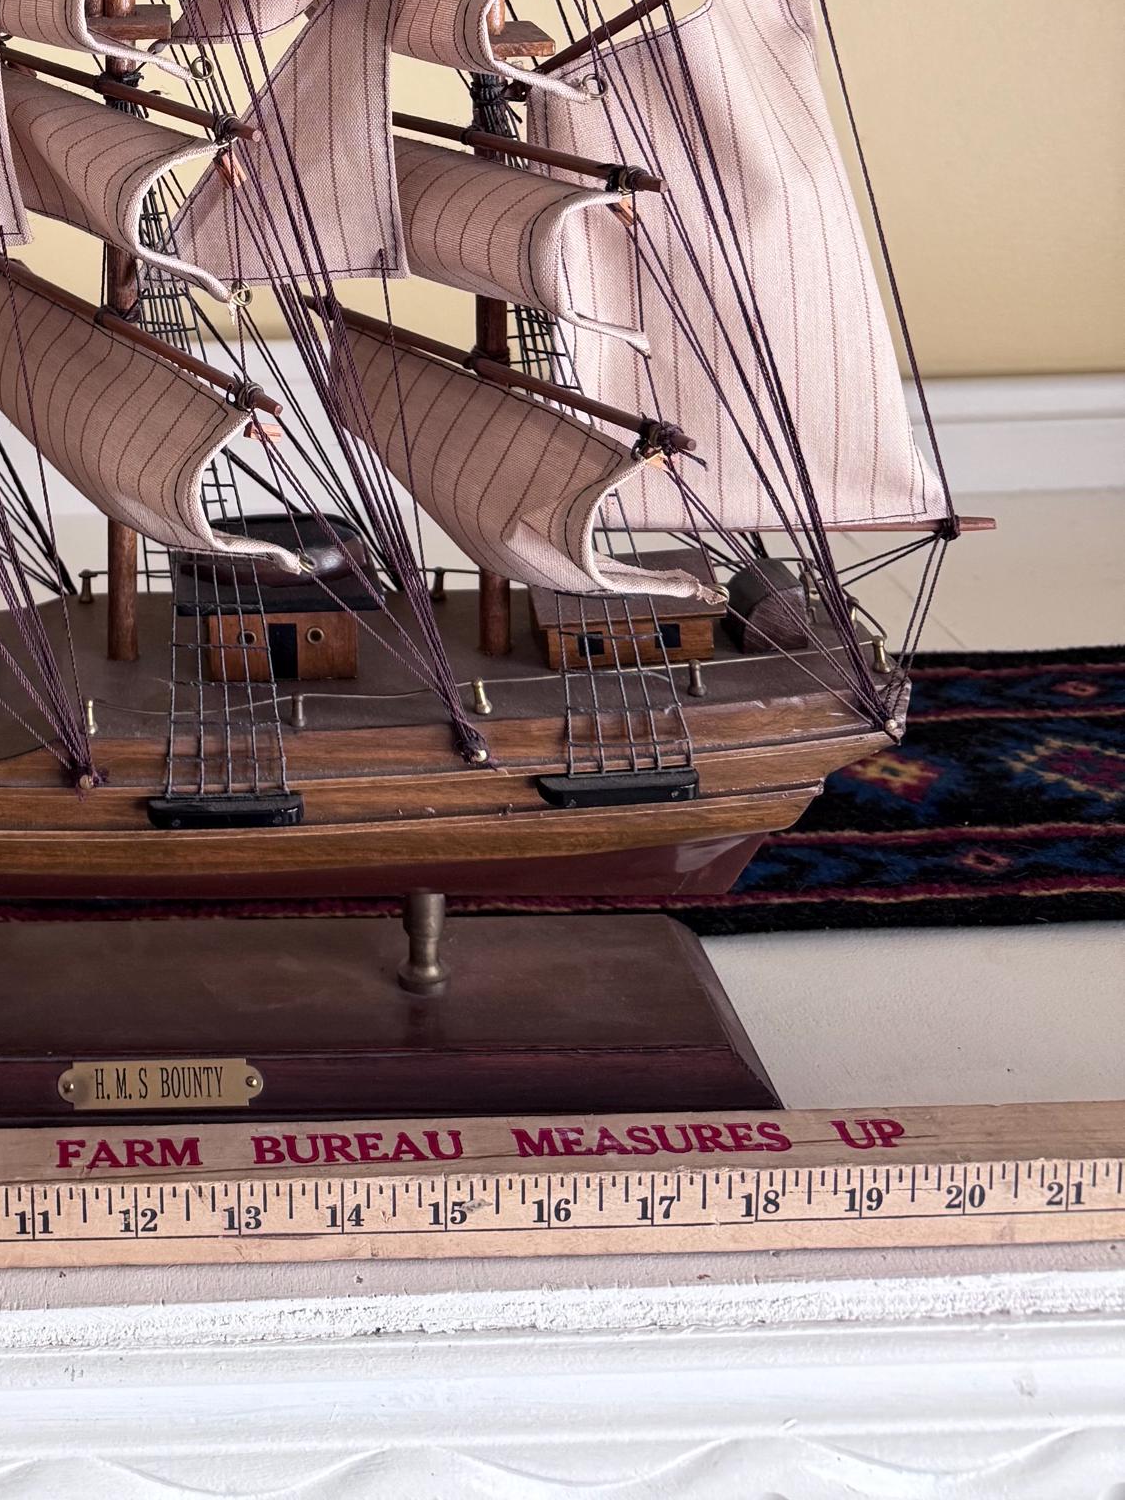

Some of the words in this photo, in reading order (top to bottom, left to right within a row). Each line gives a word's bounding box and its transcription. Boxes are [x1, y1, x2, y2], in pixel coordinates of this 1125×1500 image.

[159, 1066, 224, 1099] BOUNTY
[55, 1136, 203, 1169] FARM
[250, 1129, 464, 1165] BUREAU
[511, 1120, 793, 1158] MEASURES
[831, 1118, 905, 1150] UP
[15, 1209, 54, 1235] 11
[119, 1207, 159, 1233] 12
[224, 1205, 263, 1231] 13
[326, 1203, 366, 1228] 14
[428, 1200, 469, 1226] 15
[532, 1198, 572, 1223] 16
[636, 1195, 677, 1221] 17
[740, 1189, 781, 1218] 18
[844, 1186, 884, 1212] 19
[945, 1183, 986, 1209] 20
[1045, 1181, 1086, 1206] 21
